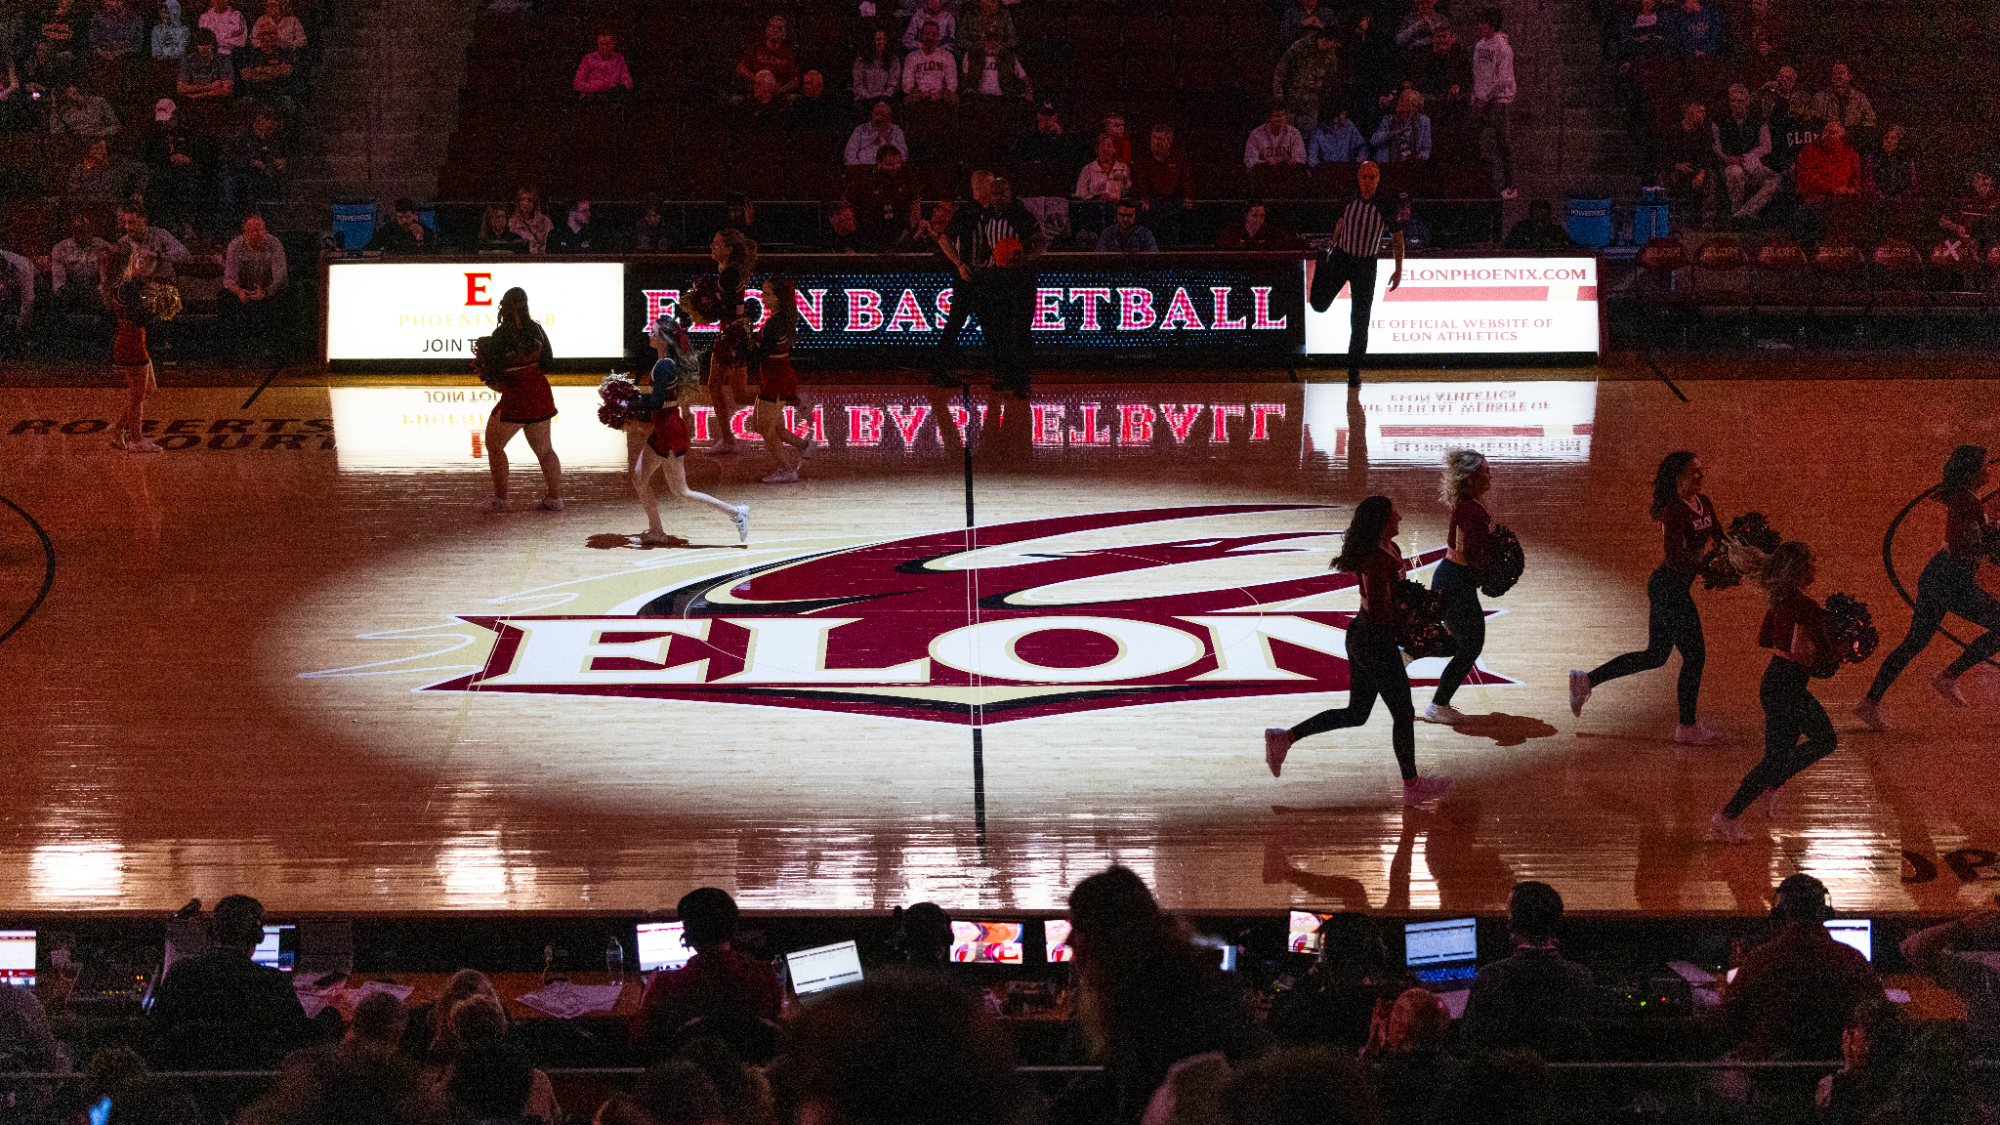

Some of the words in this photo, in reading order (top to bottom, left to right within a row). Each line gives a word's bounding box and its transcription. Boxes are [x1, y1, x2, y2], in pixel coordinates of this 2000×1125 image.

[1570, 208, 1607, 217] POWERADE
[1399, 268, 1587, 281] ELONPHOENIX.COM
[463, 272, 492, 306] E
[843, 286, 1287, 332] BASETBALL
[399, 313, 495, 327] PHOENIX
[1388, 318, 1456, 329] OFFICIAL
[1462, 318, 1529, 328] WEBSITE
[1533, 318, 1554, 329] OF
[1392, 331, 1432, 342] ELON
[1436, 331, 1518, 342] ATHLETICS
[422, 338, 462, 353] JOIN
